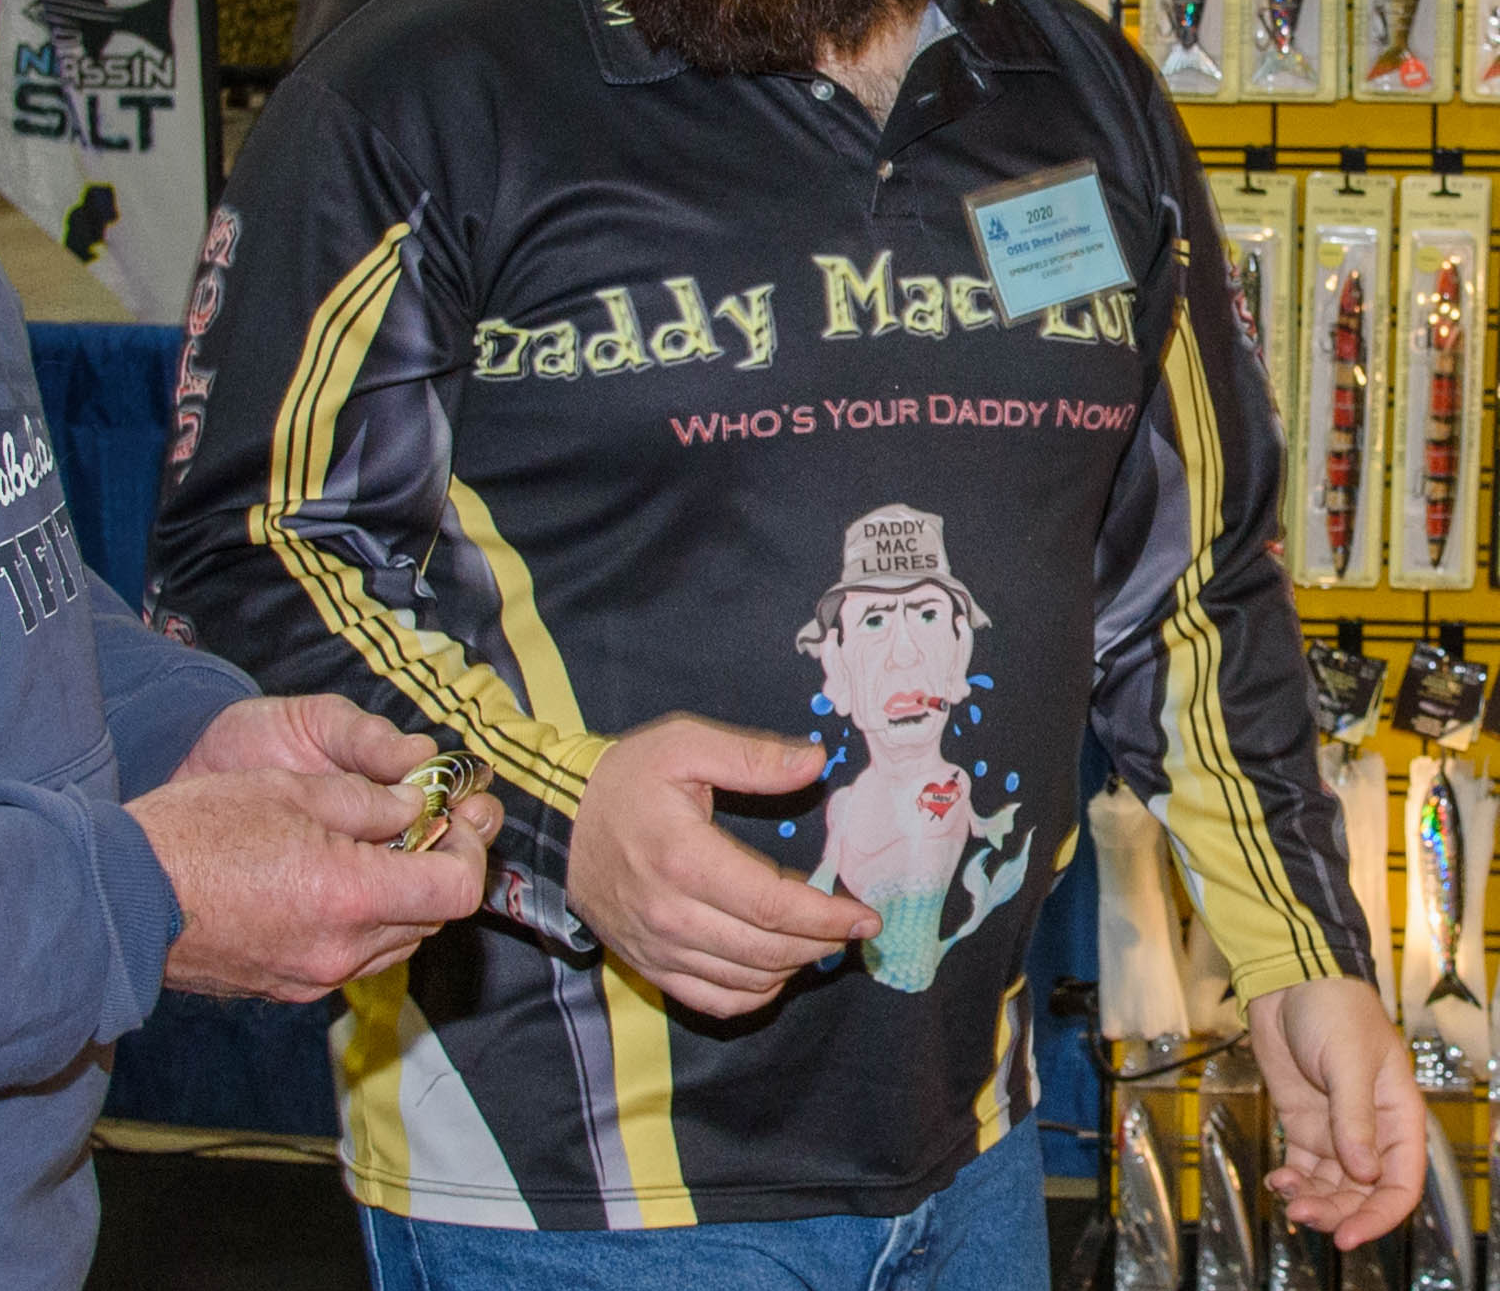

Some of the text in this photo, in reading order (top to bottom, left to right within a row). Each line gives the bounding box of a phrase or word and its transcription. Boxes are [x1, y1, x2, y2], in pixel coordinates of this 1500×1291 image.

[1026, 205, 1054, 225] 2020
[473, 275, 776, 380] Daddy
[812, 249, 994, 342] Mac
[670, 402, 817, 447] WHO'S
[823, 395, 921, 431] YOUR
[927, 393, 1049, 429] DADDY
[863, 520, 926, 539] DADDY
[875, 538, 918, 556] MAC
[861, 554, 940, 574] LURES
